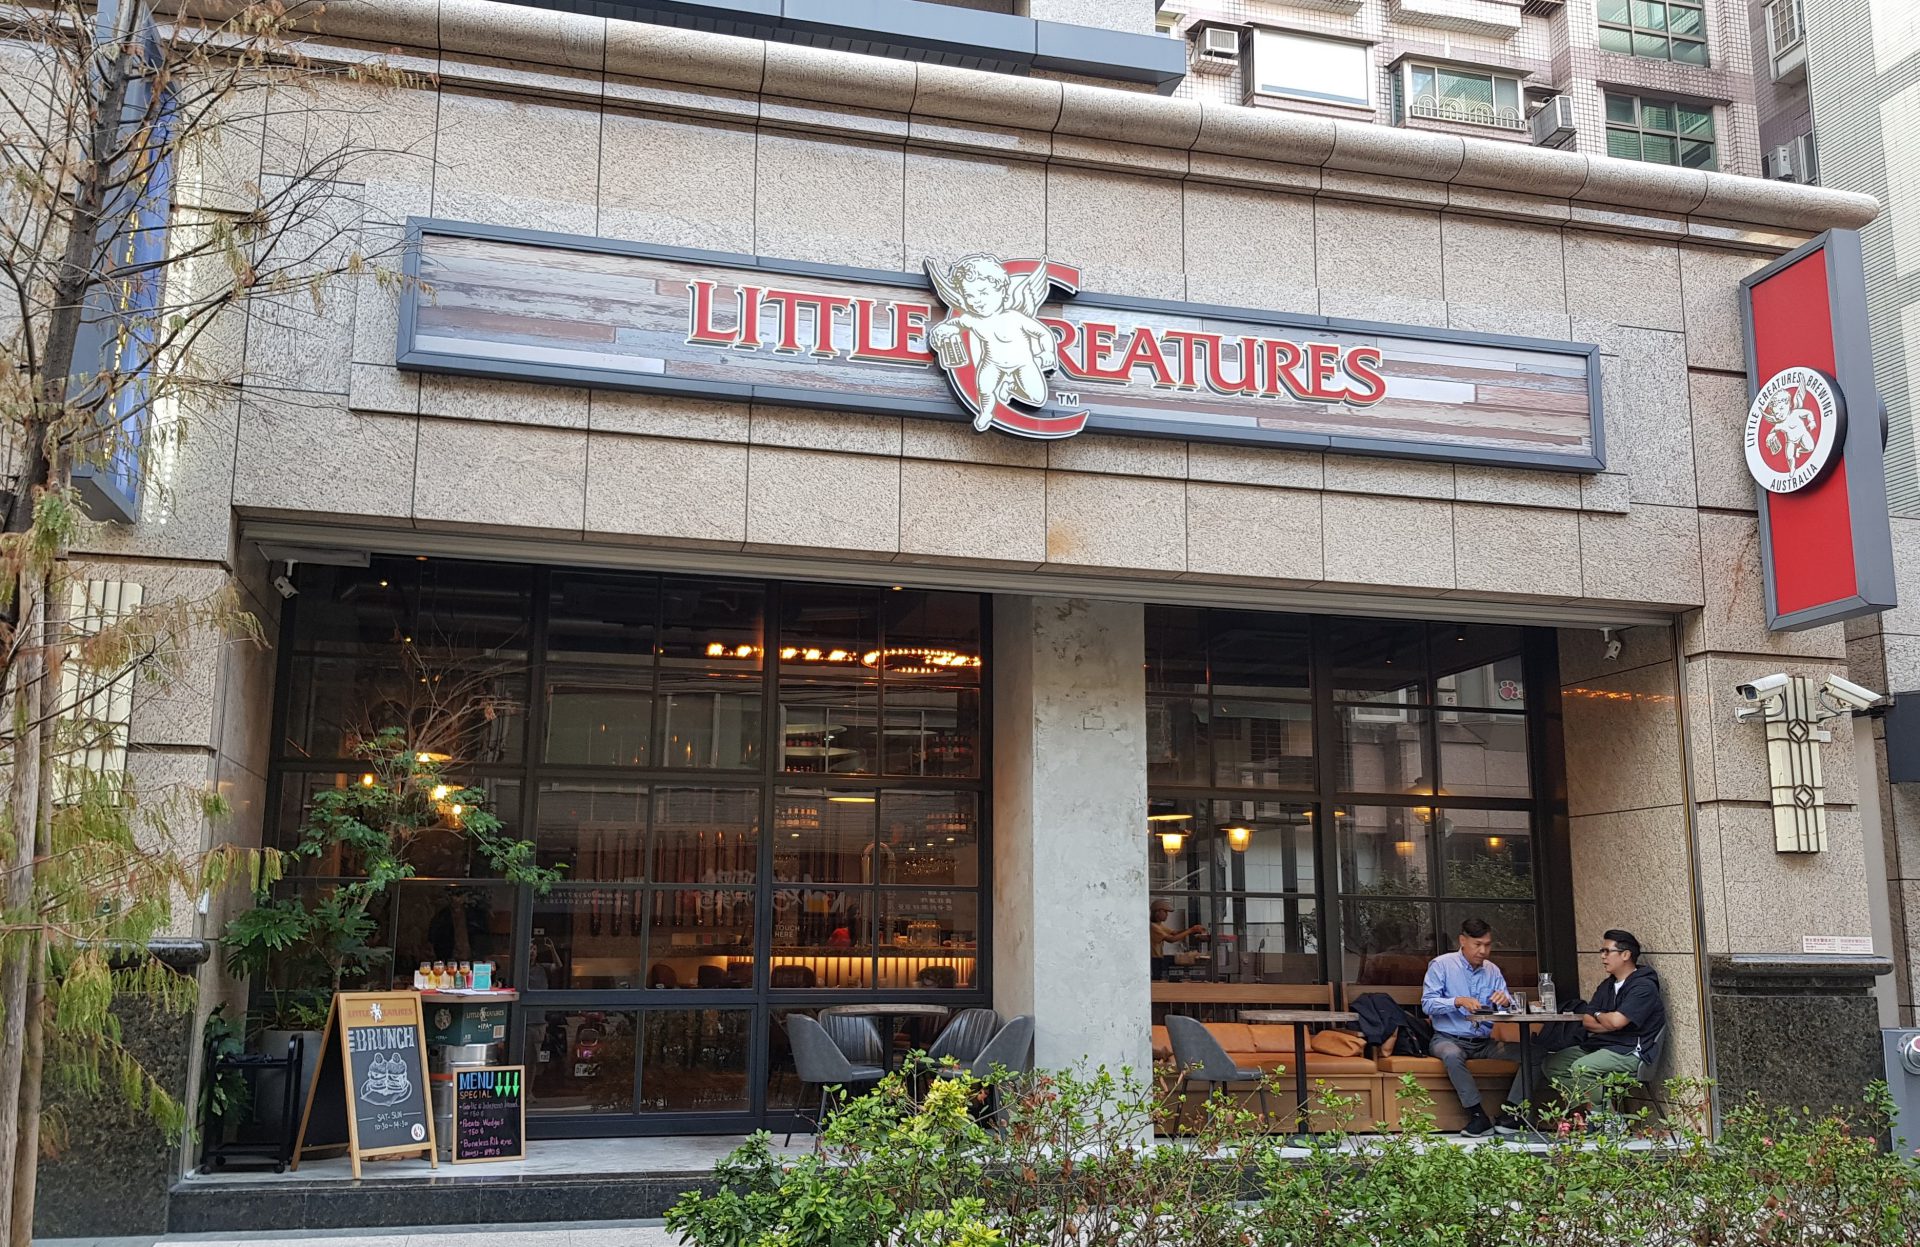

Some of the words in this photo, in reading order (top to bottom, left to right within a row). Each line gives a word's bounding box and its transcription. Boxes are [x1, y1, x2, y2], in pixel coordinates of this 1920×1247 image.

[687, 278, 934, 366] LITTLE
[944, 257, 1388, 439] CREATURES
[1057, 393, 1078, 406] TM
[1746, 412, 1760, 448] LITTLE
[1758, 372, 1803, 407] CREATURES
[1806, 375, 1833, 418] BREWING
[1769, 463, 1818, 491] AUSTRALIA
[355, 1026, 415, 1052] BRUNCH
[459, 1071, 494, 1090] MENU
[459, 1090, 492, 1100] SPECIAL
